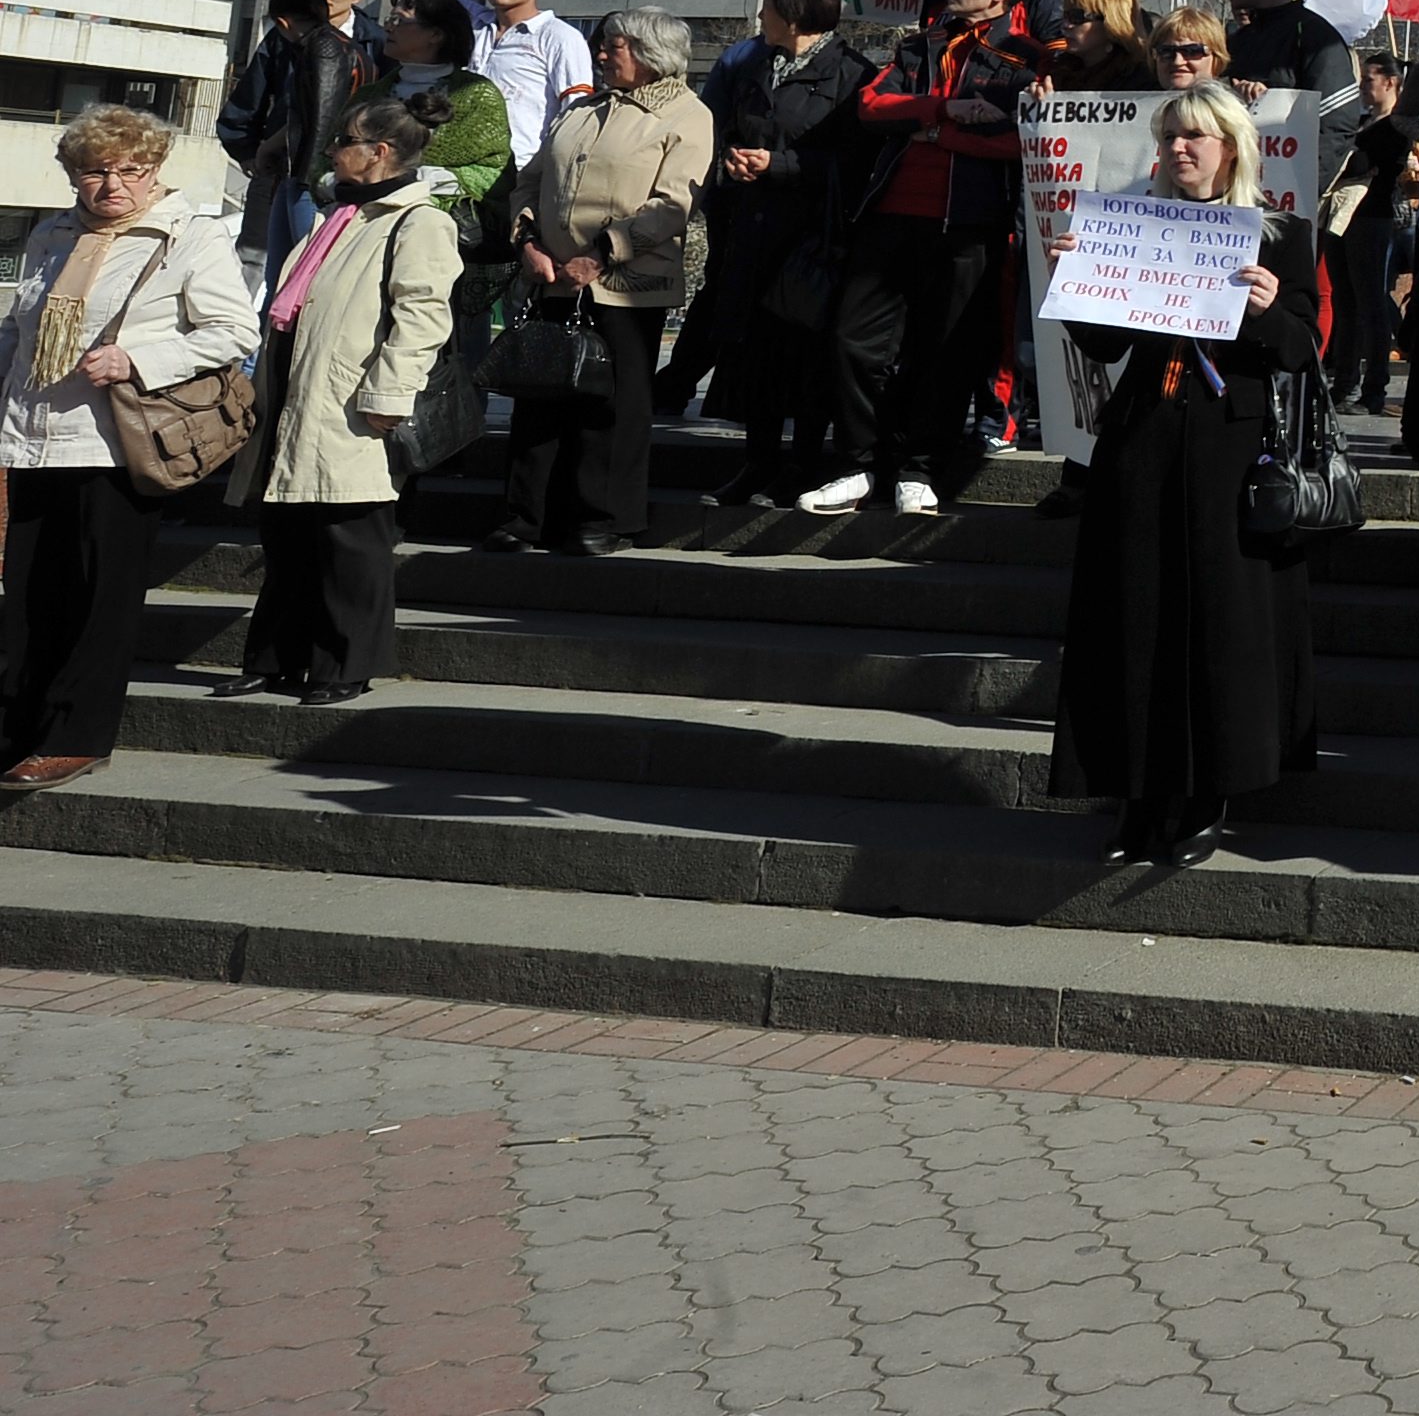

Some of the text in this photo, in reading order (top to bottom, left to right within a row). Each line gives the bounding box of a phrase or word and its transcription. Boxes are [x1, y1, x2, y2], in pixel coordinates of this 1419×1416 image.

[1020, 101, 1137, 124] КИЕВСКУЮ
[1102, 198, 1233, 226] ЮГО-ВОСТОК
[1081, 218, 1252, 249] КРЫМ С ВАМИ!
[1077, 239, 1239, 270] КРЫМ ЗА ВАС!
[1091, 263, 1226, 292] МЫ ВМЕСТЕ!
[1060, 280, 1193, 309] СВОИХ НЕ
[1127, 309, 1231, 335] БРОСАЕМ!
